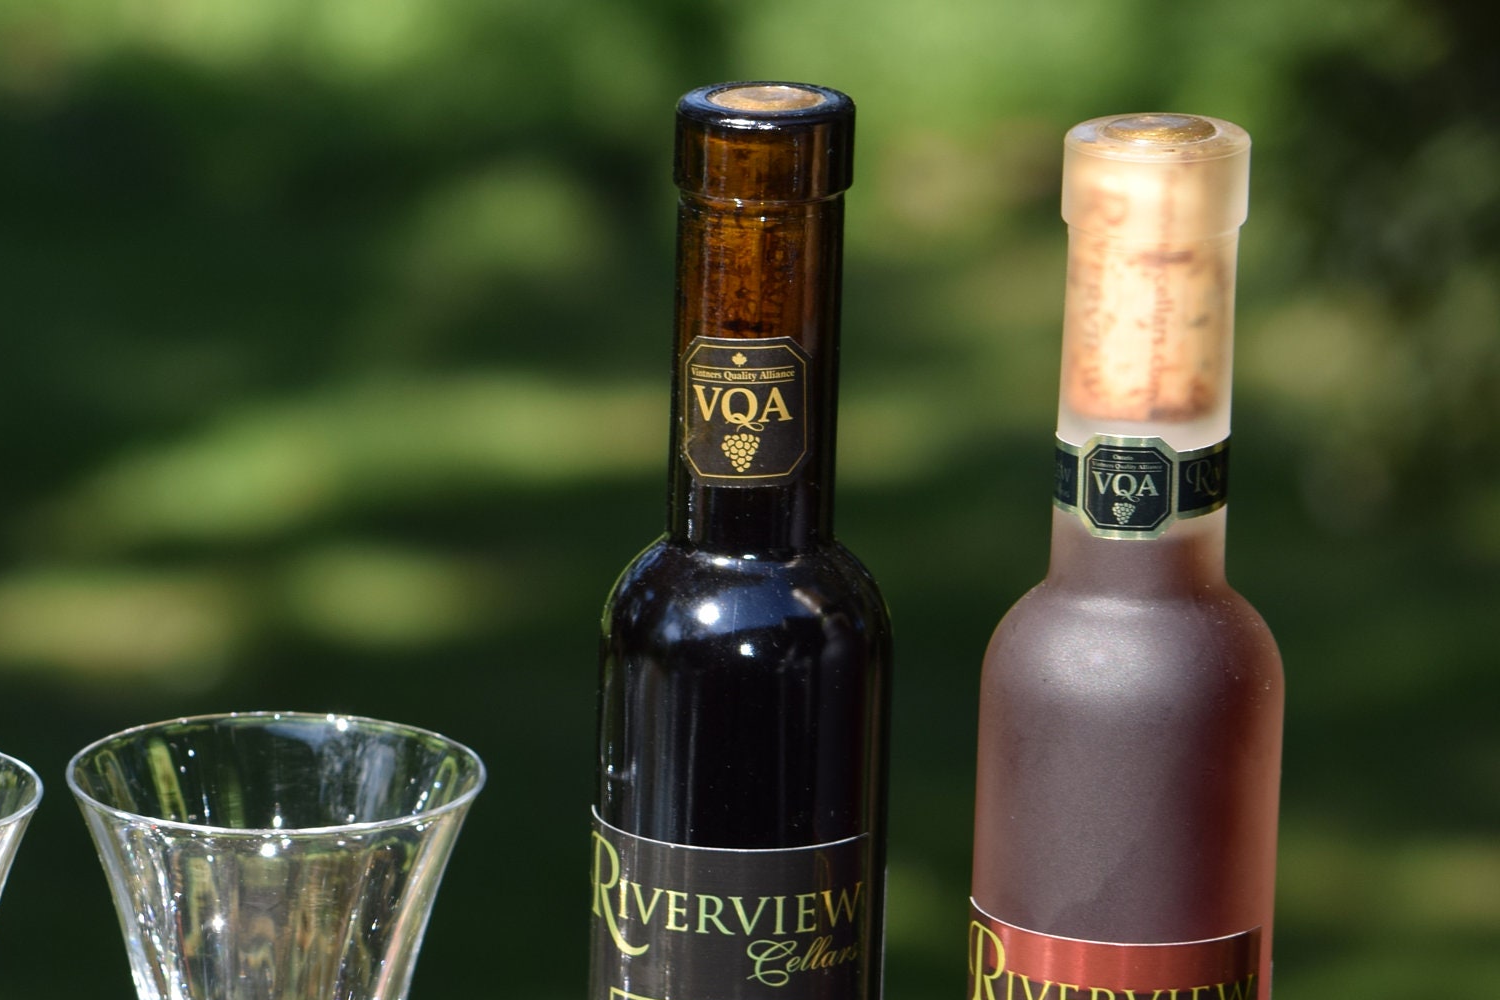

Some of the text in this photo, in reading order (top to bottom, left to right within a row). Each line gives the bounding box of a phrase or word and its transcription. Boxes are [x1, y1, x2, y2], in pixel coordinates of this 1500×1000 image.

[691, 367, 796, 382] Vintners Quality Alliance
[692, 384, 794, 432] VQA
[1092, 470, 1160, 503] VQA
[591, 830, 863, 956] RIVERVIEW
[746, 935, 859, 987] Cellars
